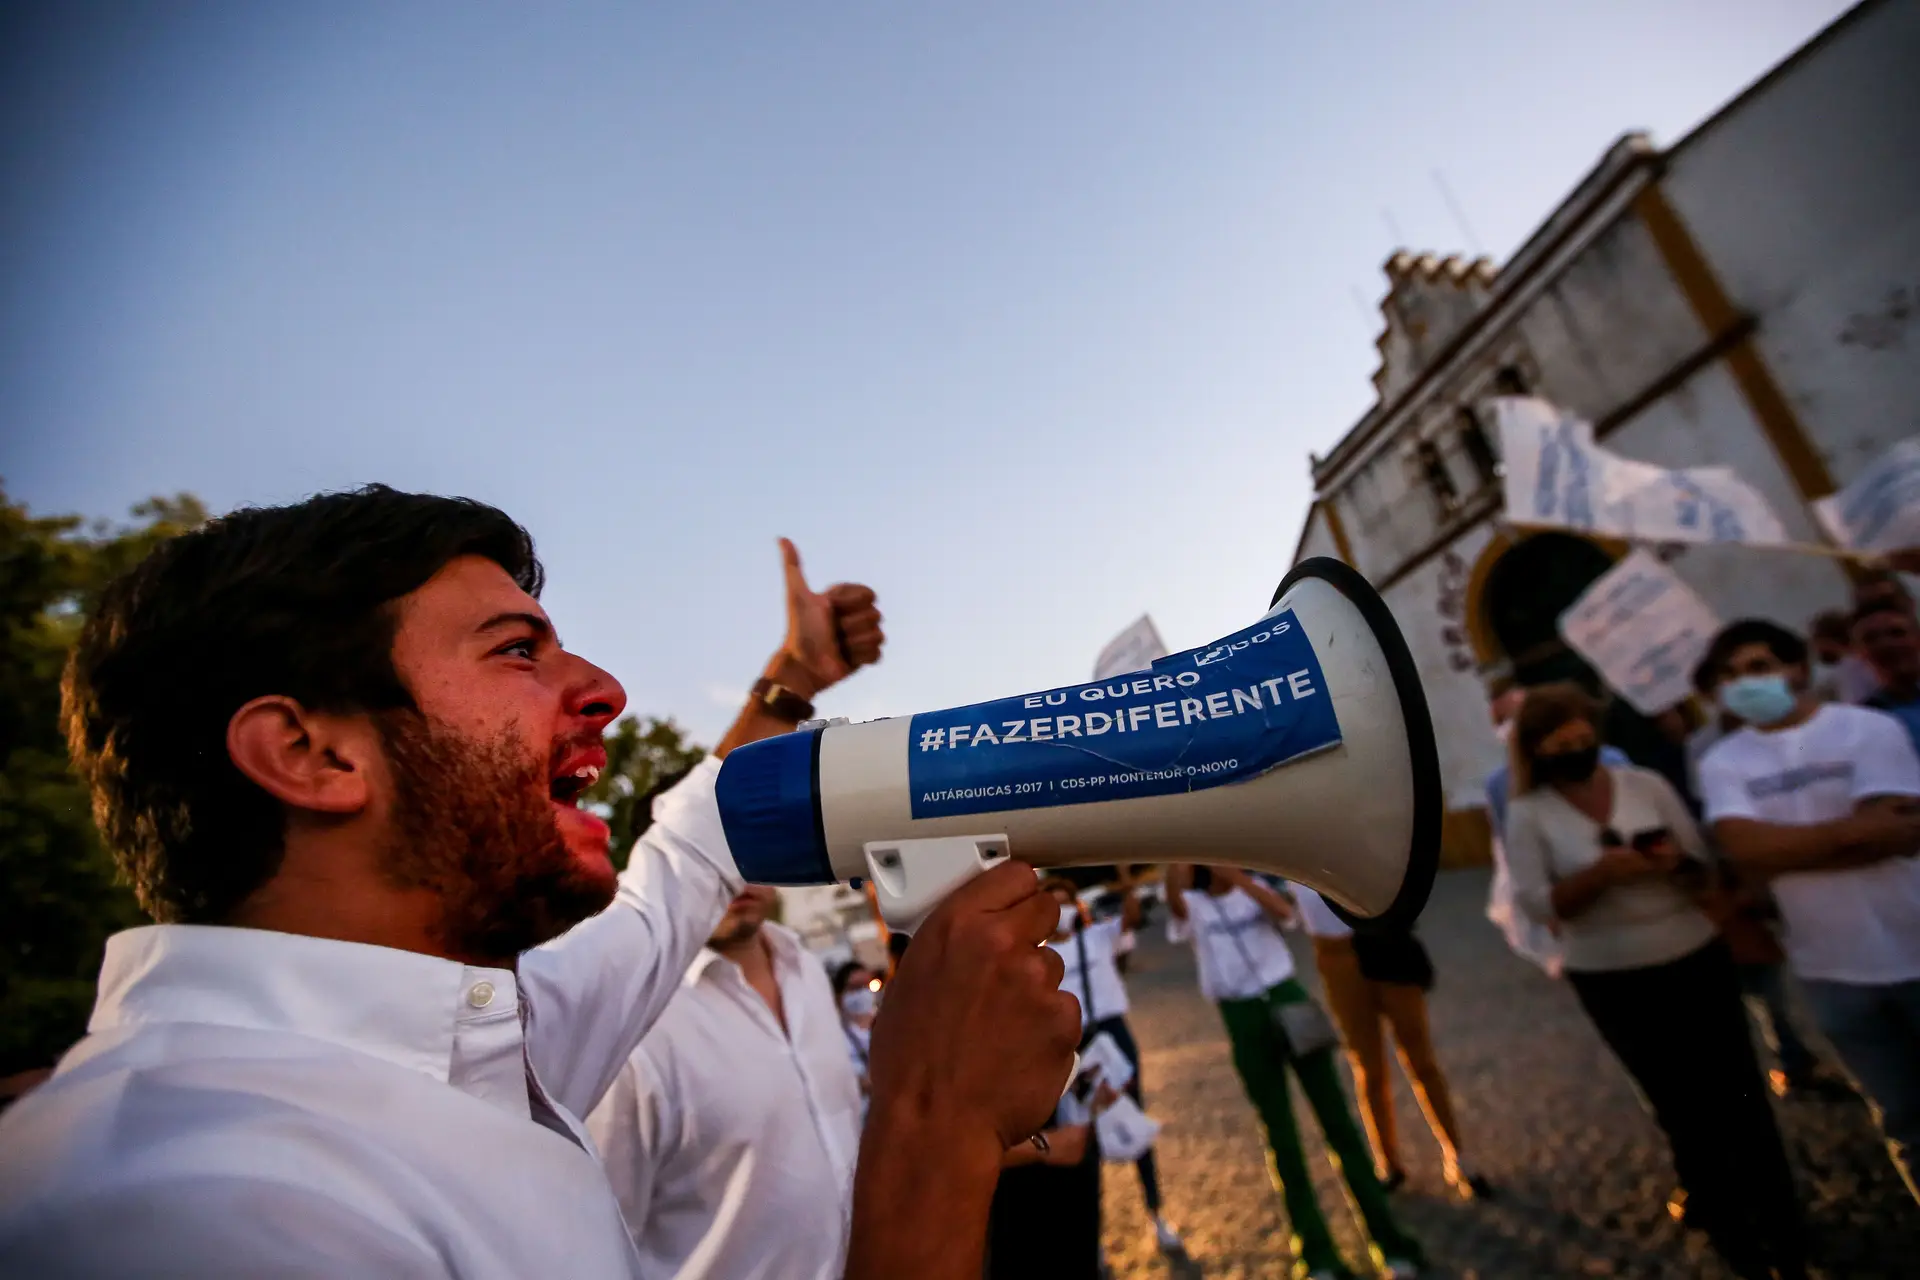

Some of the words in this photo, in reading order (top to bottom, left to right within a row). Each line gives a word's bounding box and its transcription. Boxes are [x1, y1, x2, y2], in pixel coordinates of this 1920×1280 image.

[919, 668, 1316, 752] #FAZERDIFERENTE
[1024, 692, 1067, 709] EU
[1079, 671, 1200, 701] QUERO
[922, 785, 1012, 803] AUTÁRQUICAS
[1015, 782, 1043, 794] 2017
[1061, 775, 1106, 789] CDS-PP
[1109, 758, 1239, 784] MONTEMOR-O-NOVO
